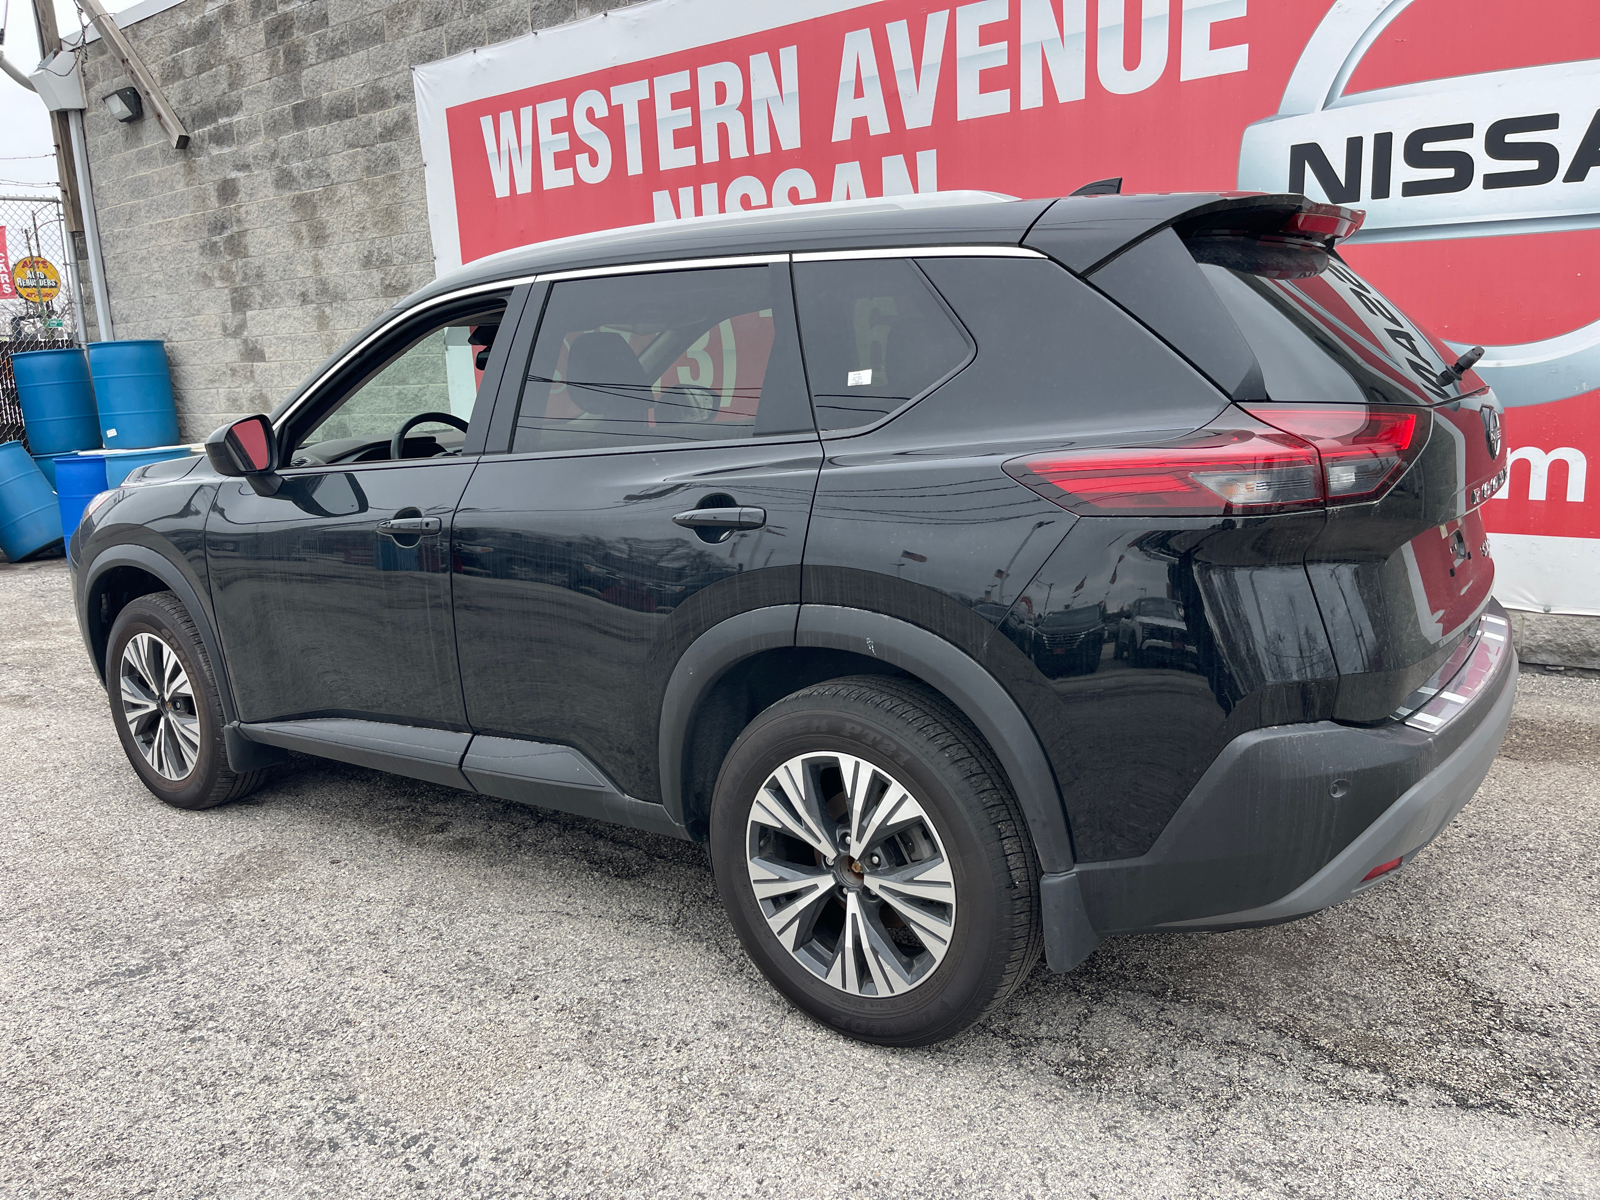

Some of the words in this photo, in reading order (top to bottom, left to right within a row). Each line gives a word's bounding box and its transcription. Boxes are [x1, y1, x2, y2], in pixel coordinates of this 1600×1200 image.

[479, 44, 801, 199] WESTERN
[831, 0, 1249, 142] AVENUE
[16, 278, 57, 287] REBUDERS
